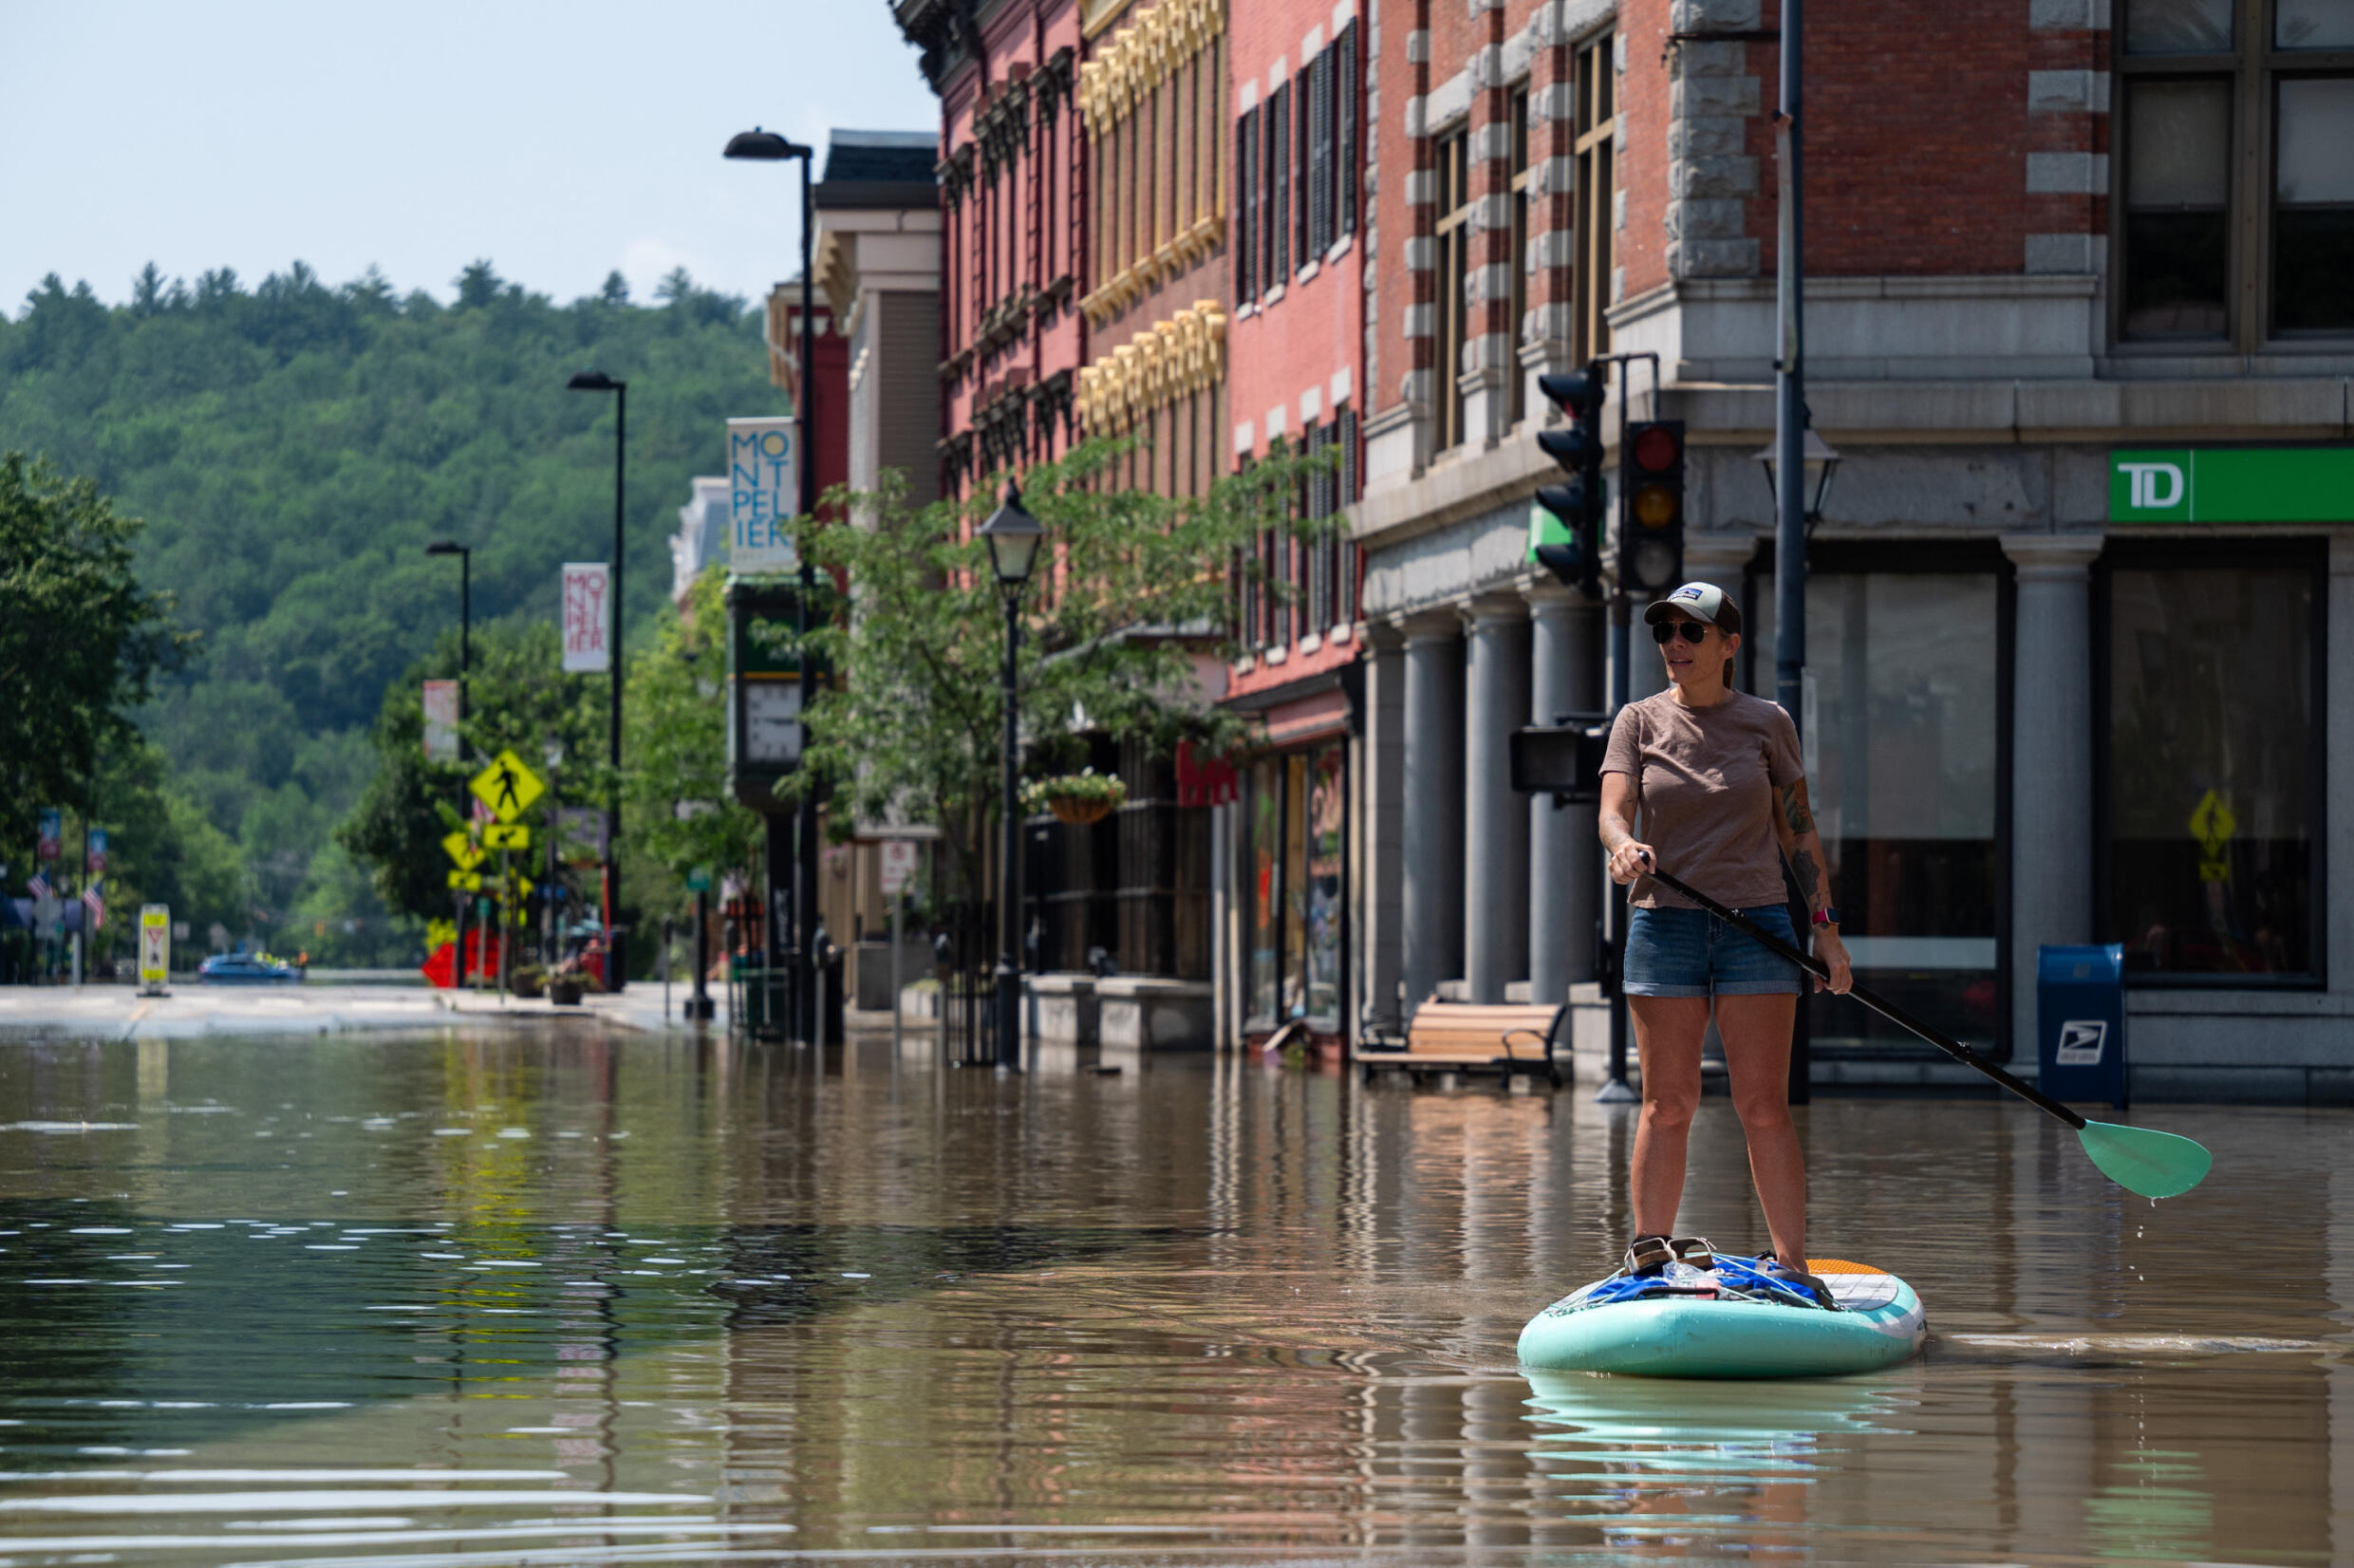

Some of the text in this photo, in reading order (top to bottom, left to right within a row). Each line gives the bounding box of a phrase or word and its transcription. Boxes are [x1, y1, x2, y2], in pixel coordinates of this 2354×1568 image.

[732, 430, 789, 458] MO
[733, 459, 789, 490] NT
[2117, 462, 2184, 508] TD
[733, 489, 790, 518] PEL
